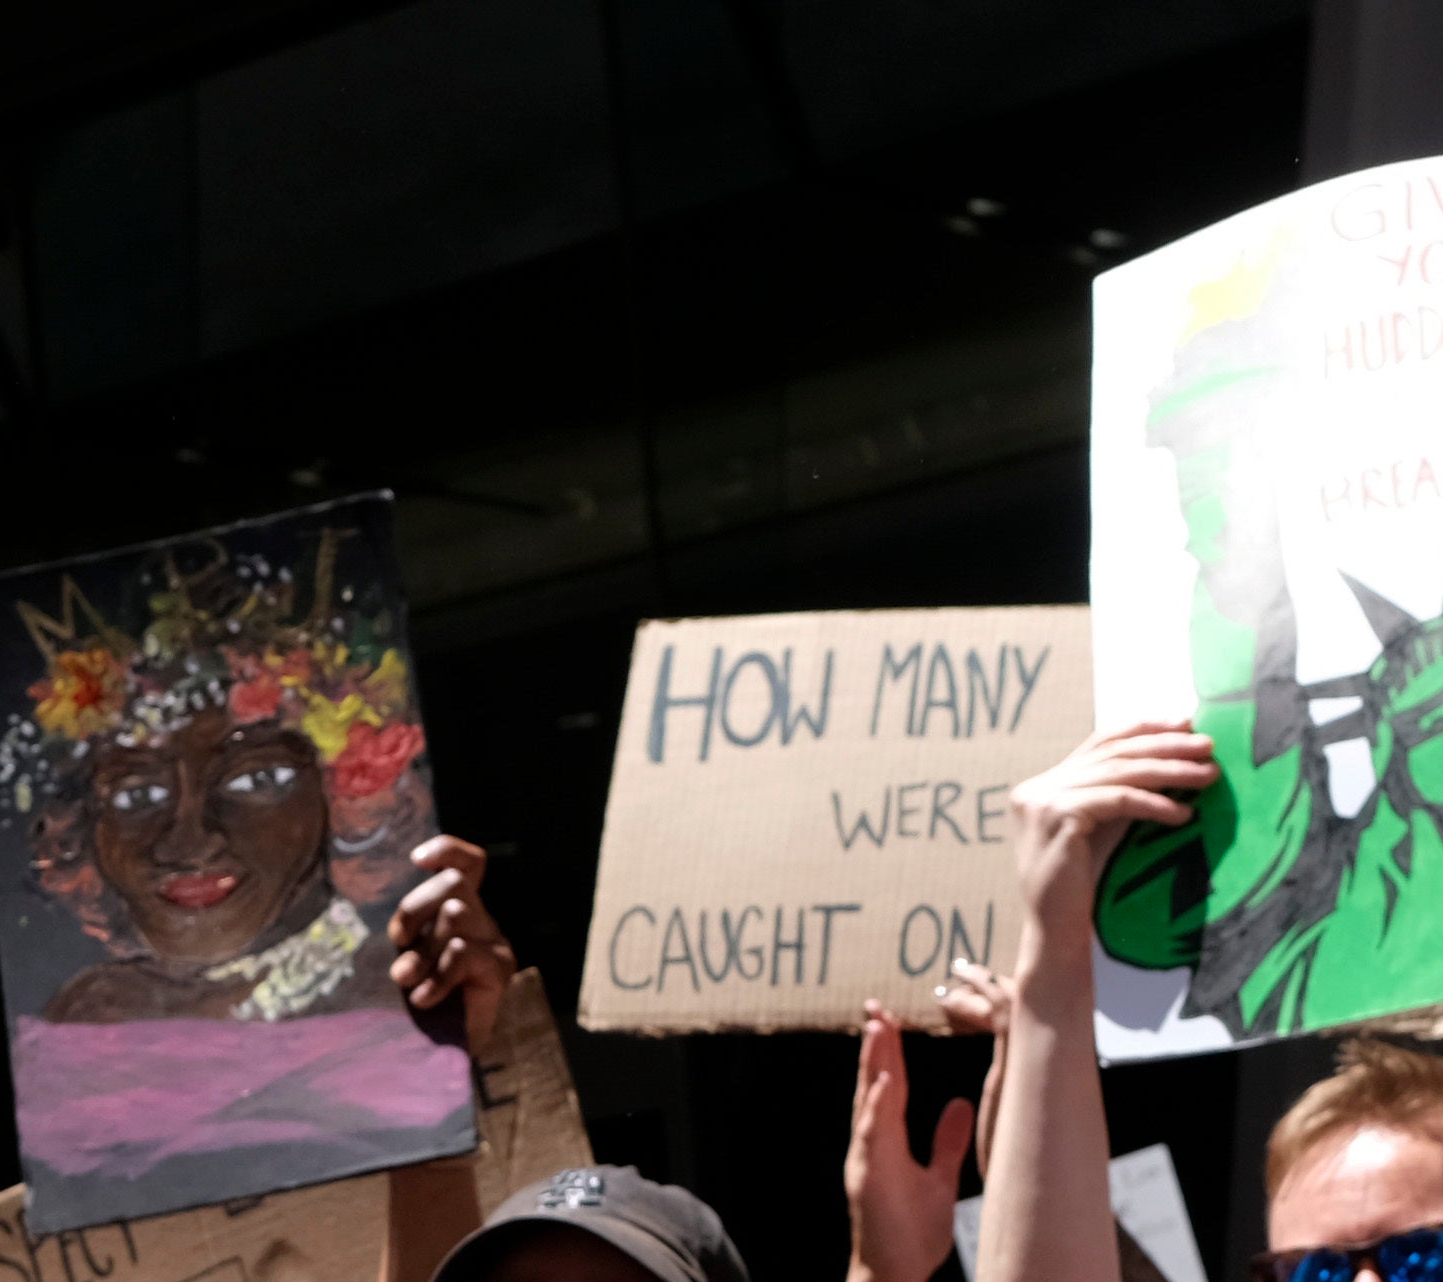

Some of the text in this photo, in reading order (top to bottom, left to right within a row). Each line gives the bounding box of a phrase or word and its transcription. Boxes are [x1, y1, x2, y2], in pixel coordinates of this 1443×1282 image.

[646, 642, 1051, 764] HOW MANY
[832, 781, 1012, 848] WERE
[610, 901, 998, 993] CAUGHT ON
